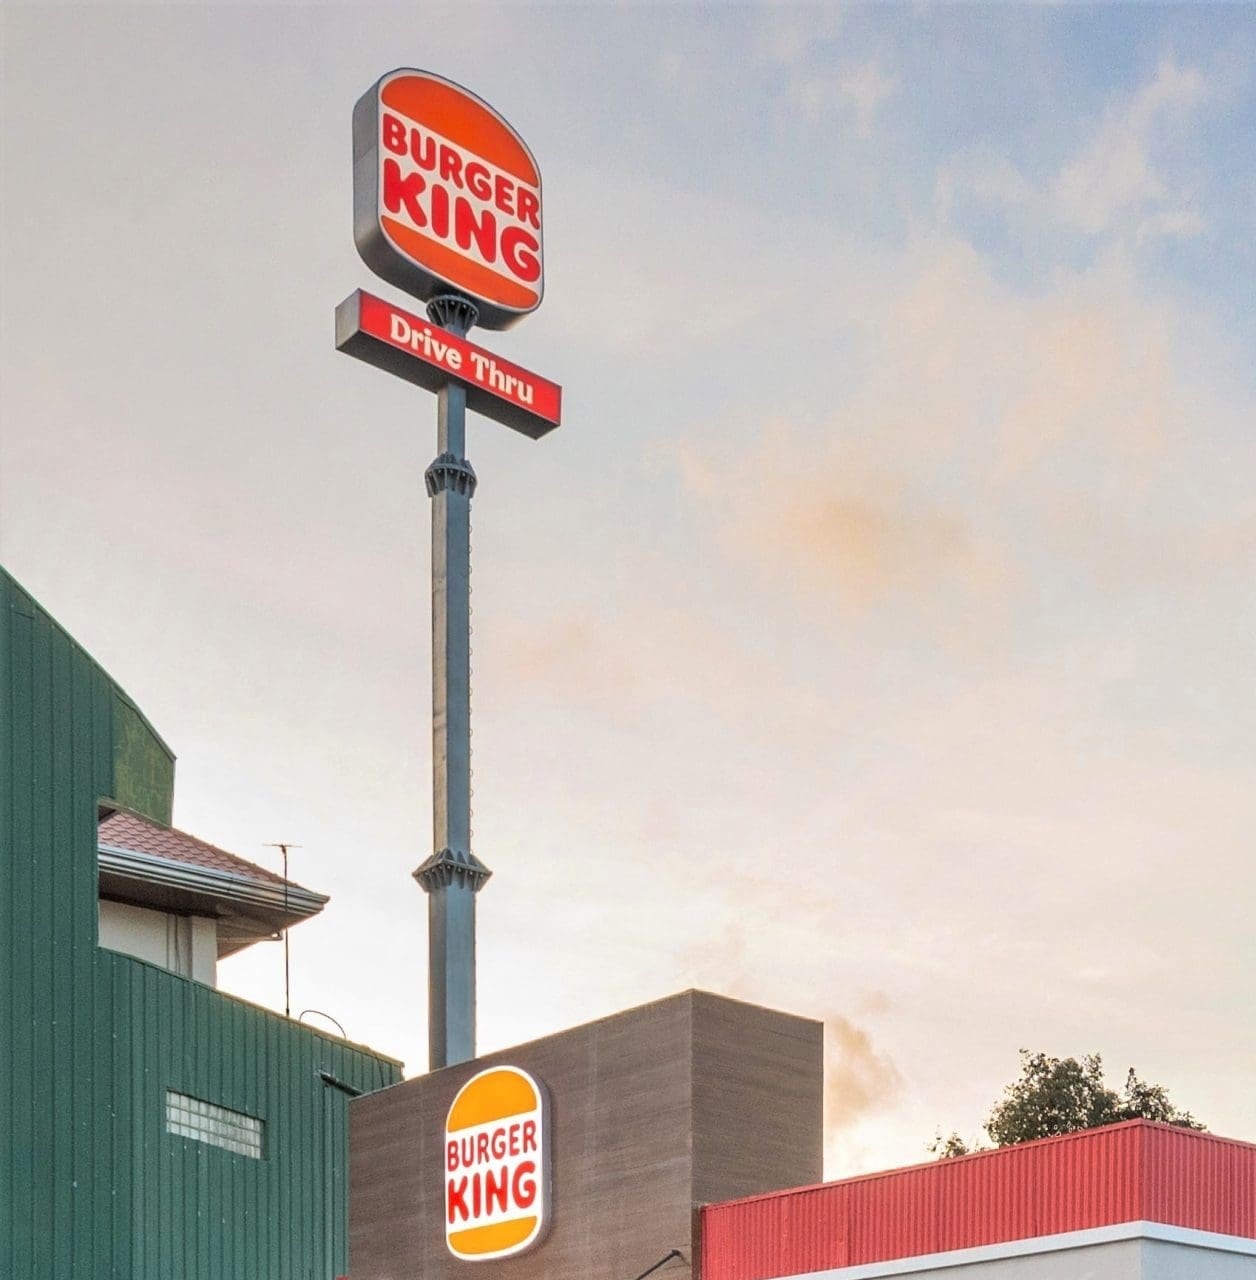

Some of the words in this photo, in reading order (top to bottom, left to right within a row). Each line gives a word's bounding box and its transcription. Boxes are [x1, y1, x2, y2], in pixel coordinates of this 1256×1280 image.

[383, 113, 540, 230] BURGER
[383, 158, 540, 282] KING
[389, 313, 463, 370] Drive
[470, 352, 534, 405] Thru
[447, 1120, 537, 1172] BURGER
[448, 1161, 536, 1224] KING
